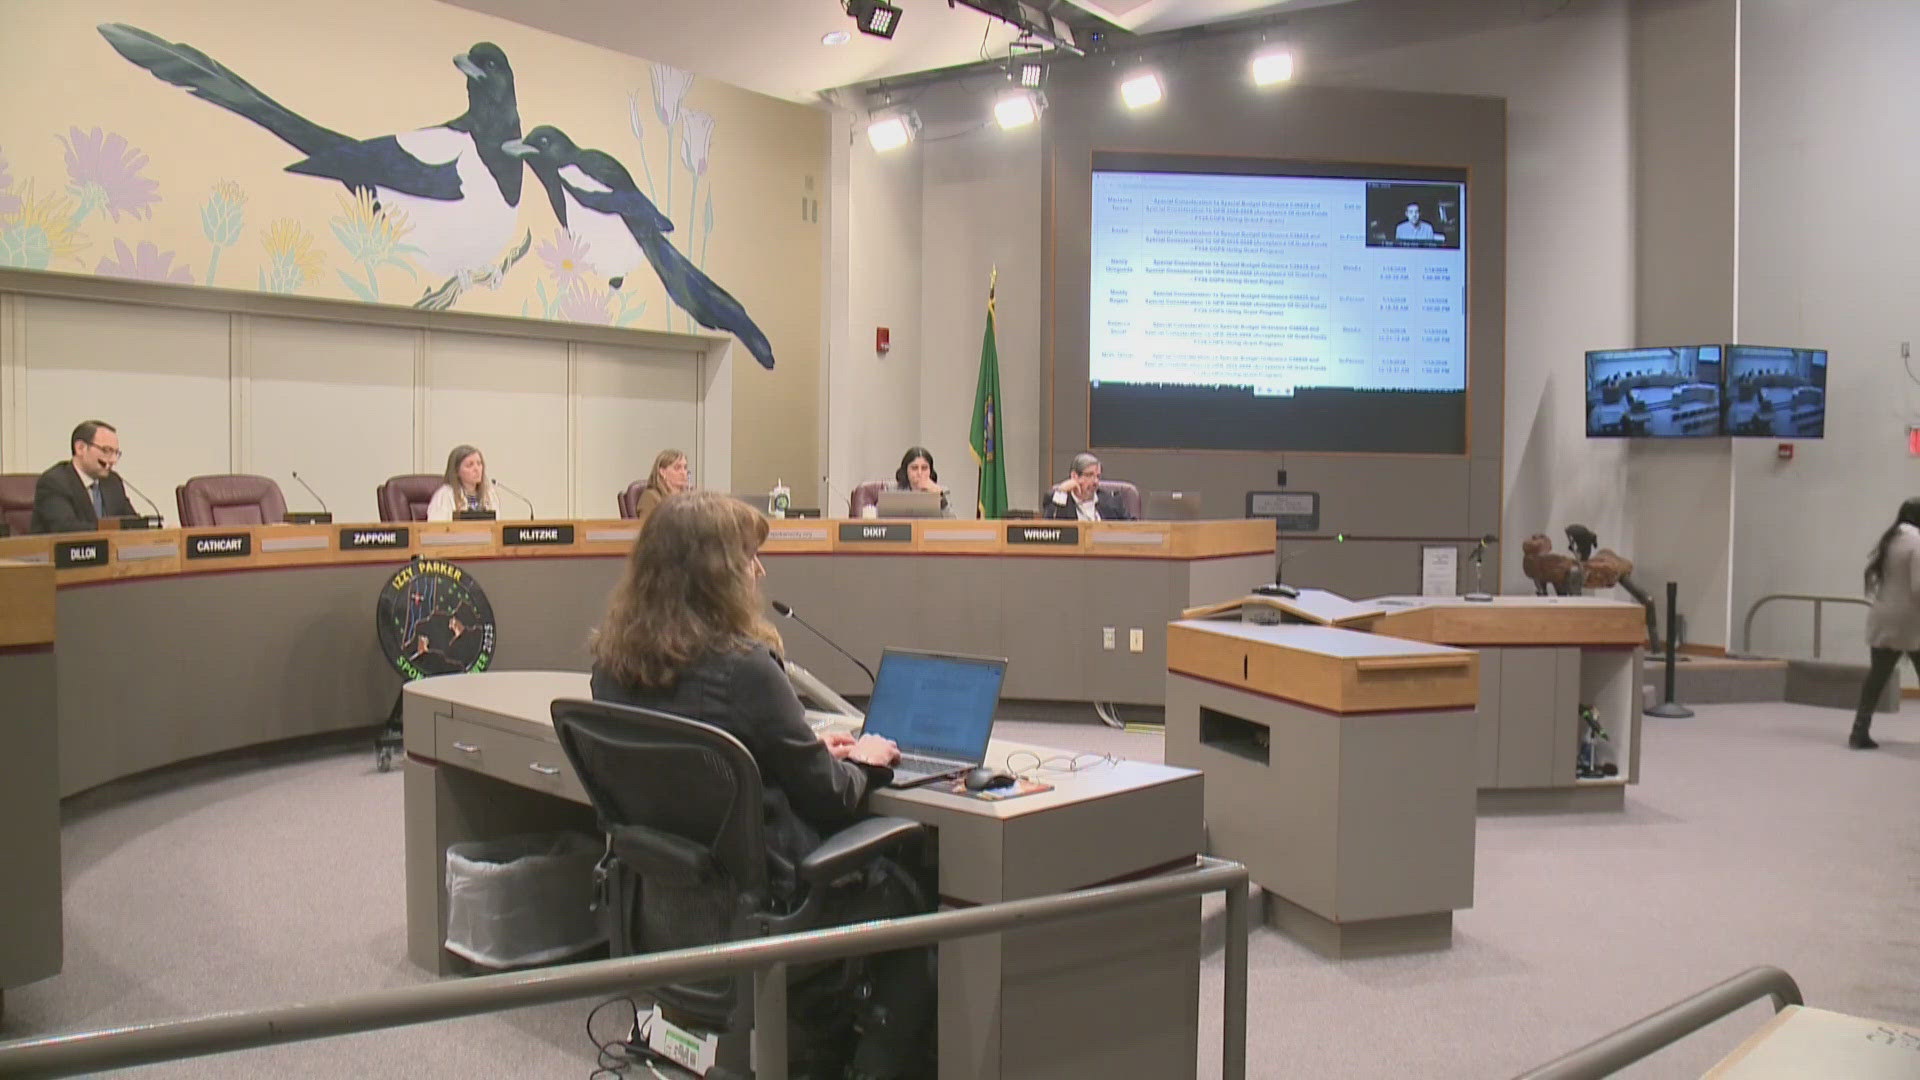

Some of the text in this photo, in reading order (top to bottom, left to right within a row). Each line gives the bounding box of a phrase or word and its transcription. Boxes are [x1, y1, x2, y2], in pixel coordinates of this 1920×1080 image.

[353, 532, 396, 545] ZAPPONE
[519, 528, 558, 541] KLITZKE
[862, 526, 888, 539] DIXIT
[1023, 529, 1061, 541] WRIGHT
[196, 538, 243, 553] CATHCART
[70, 547, 97, 561] DILLON
[392, 562, 463, 591] IZZY PARKER
